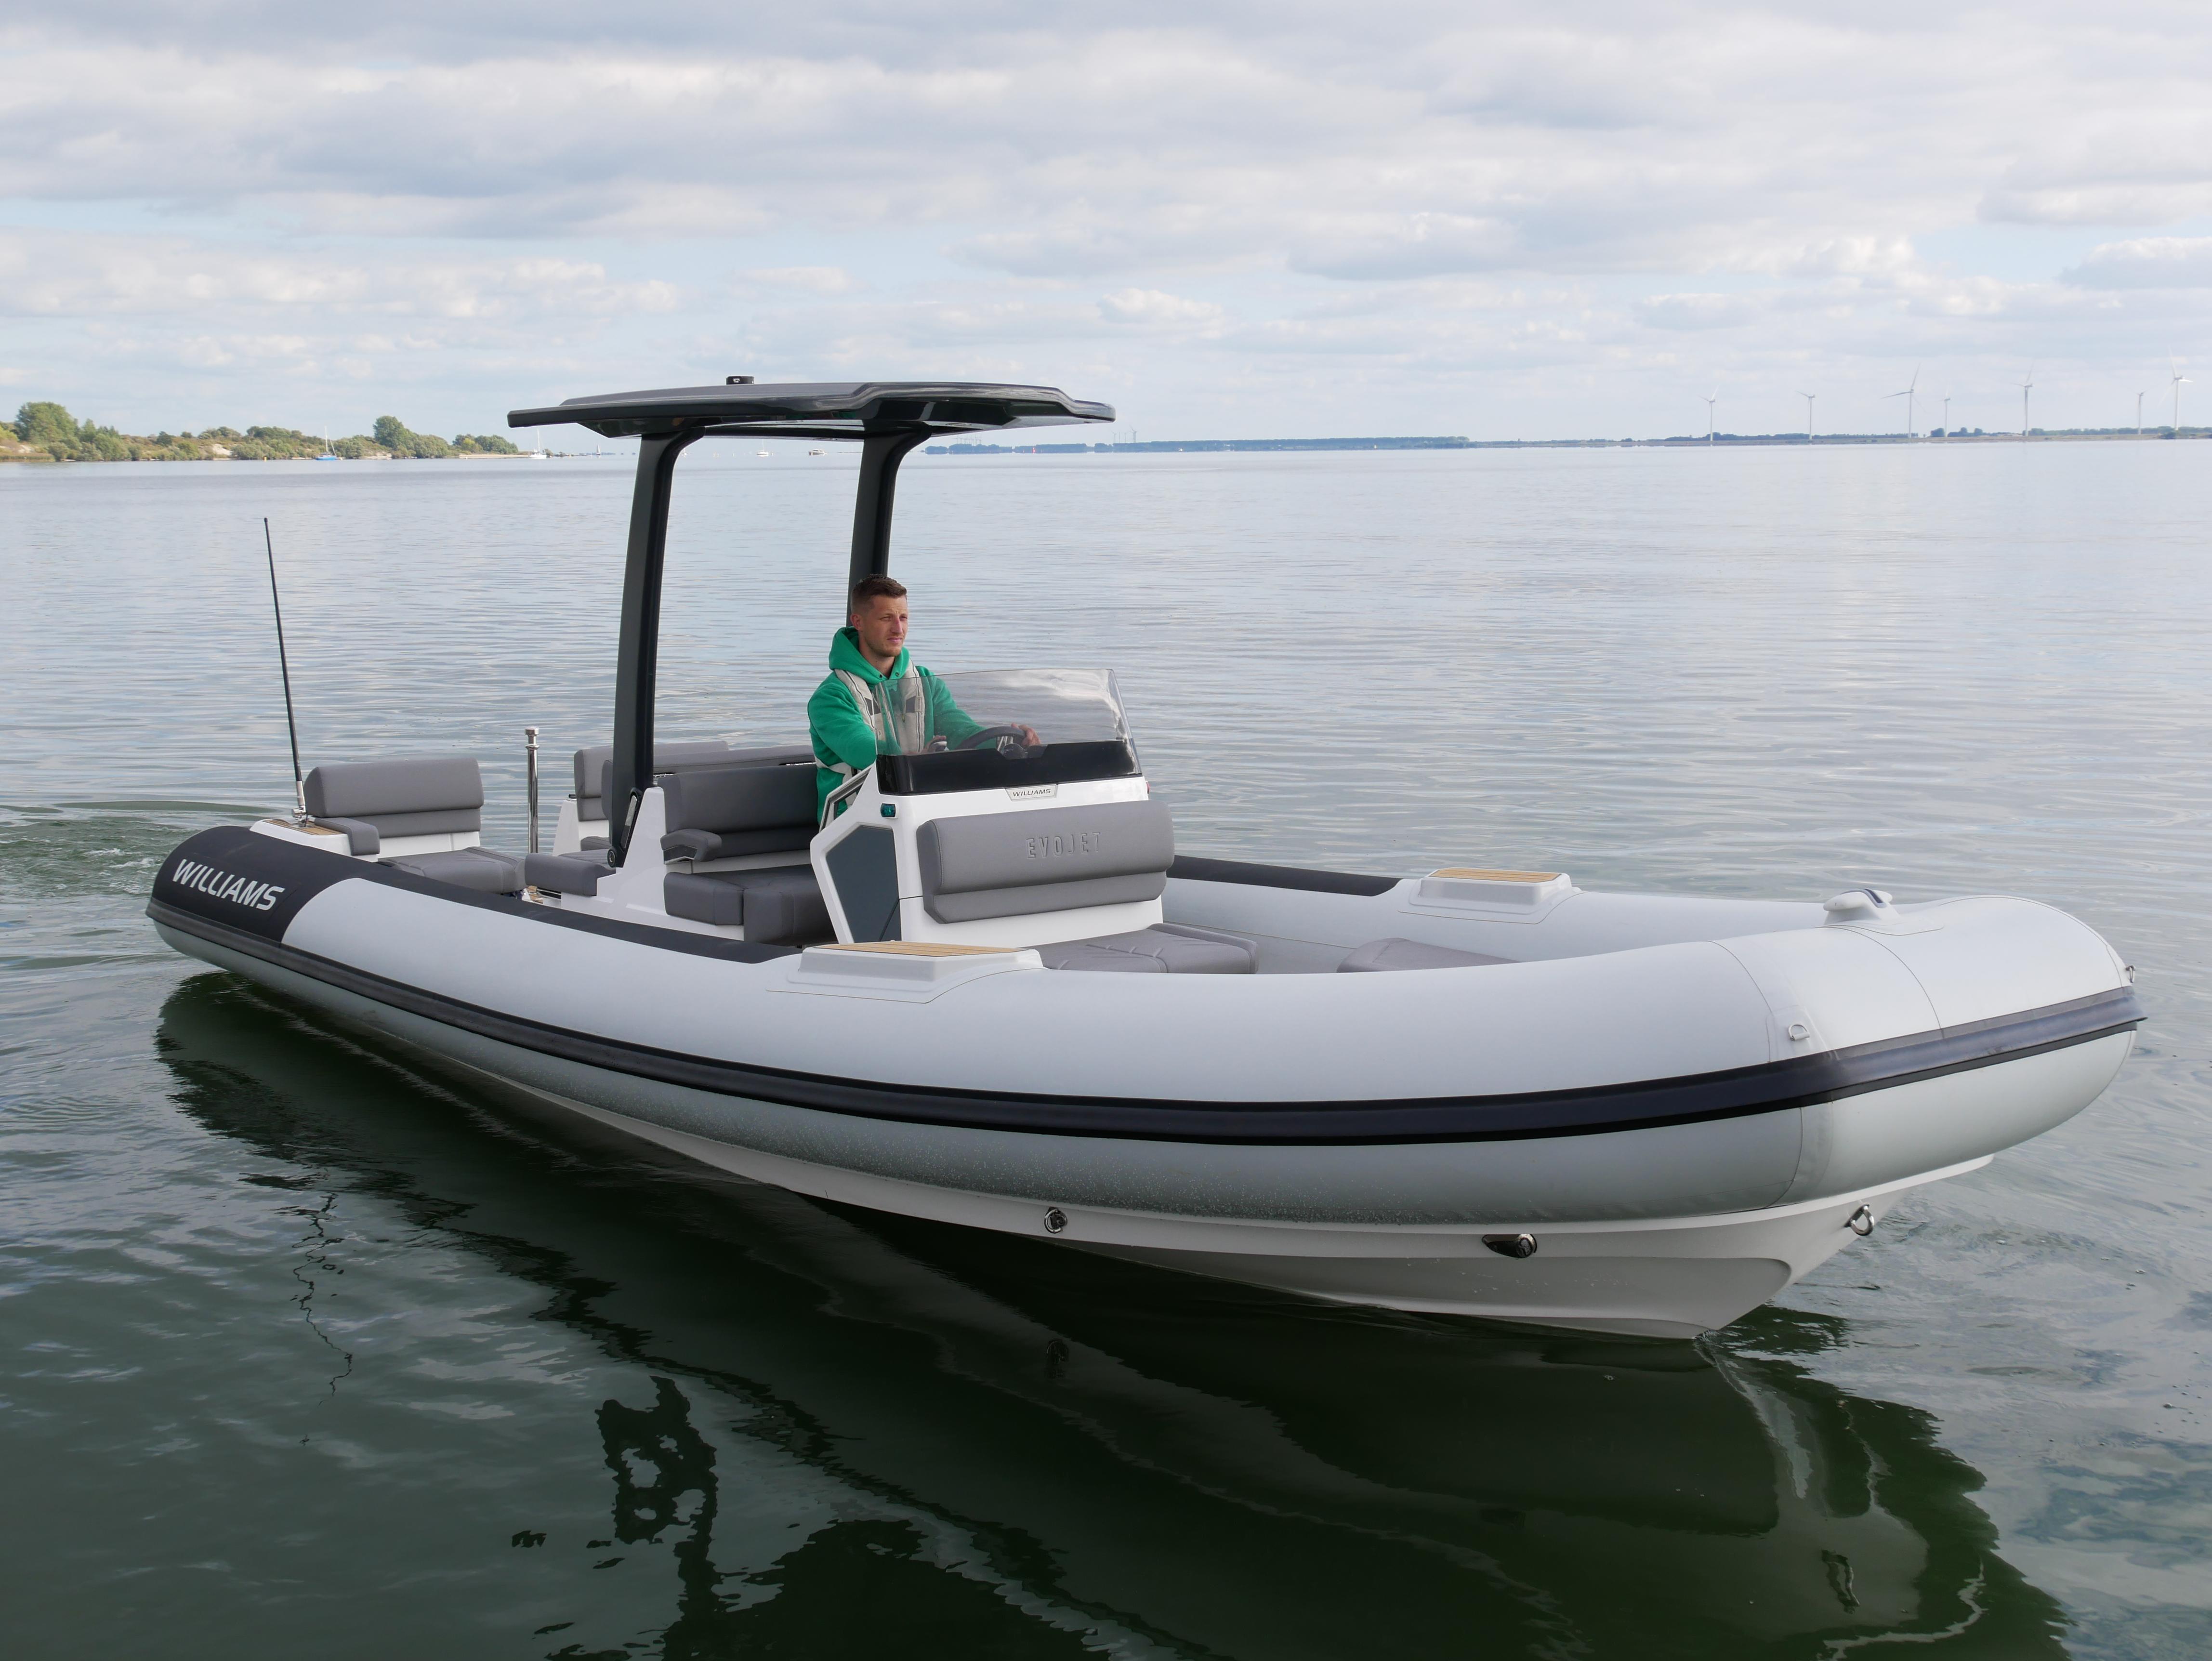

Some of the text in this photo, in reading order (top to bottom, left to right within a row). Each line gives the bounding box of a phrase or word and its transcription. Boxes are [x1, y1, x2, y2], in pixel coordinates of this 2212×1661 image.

[1013, 789, 1051, 797] WILLIAMS
[1026, 832, 1100, 858] EVOJET
[172, 859, 285, 910] WILLIAMS
